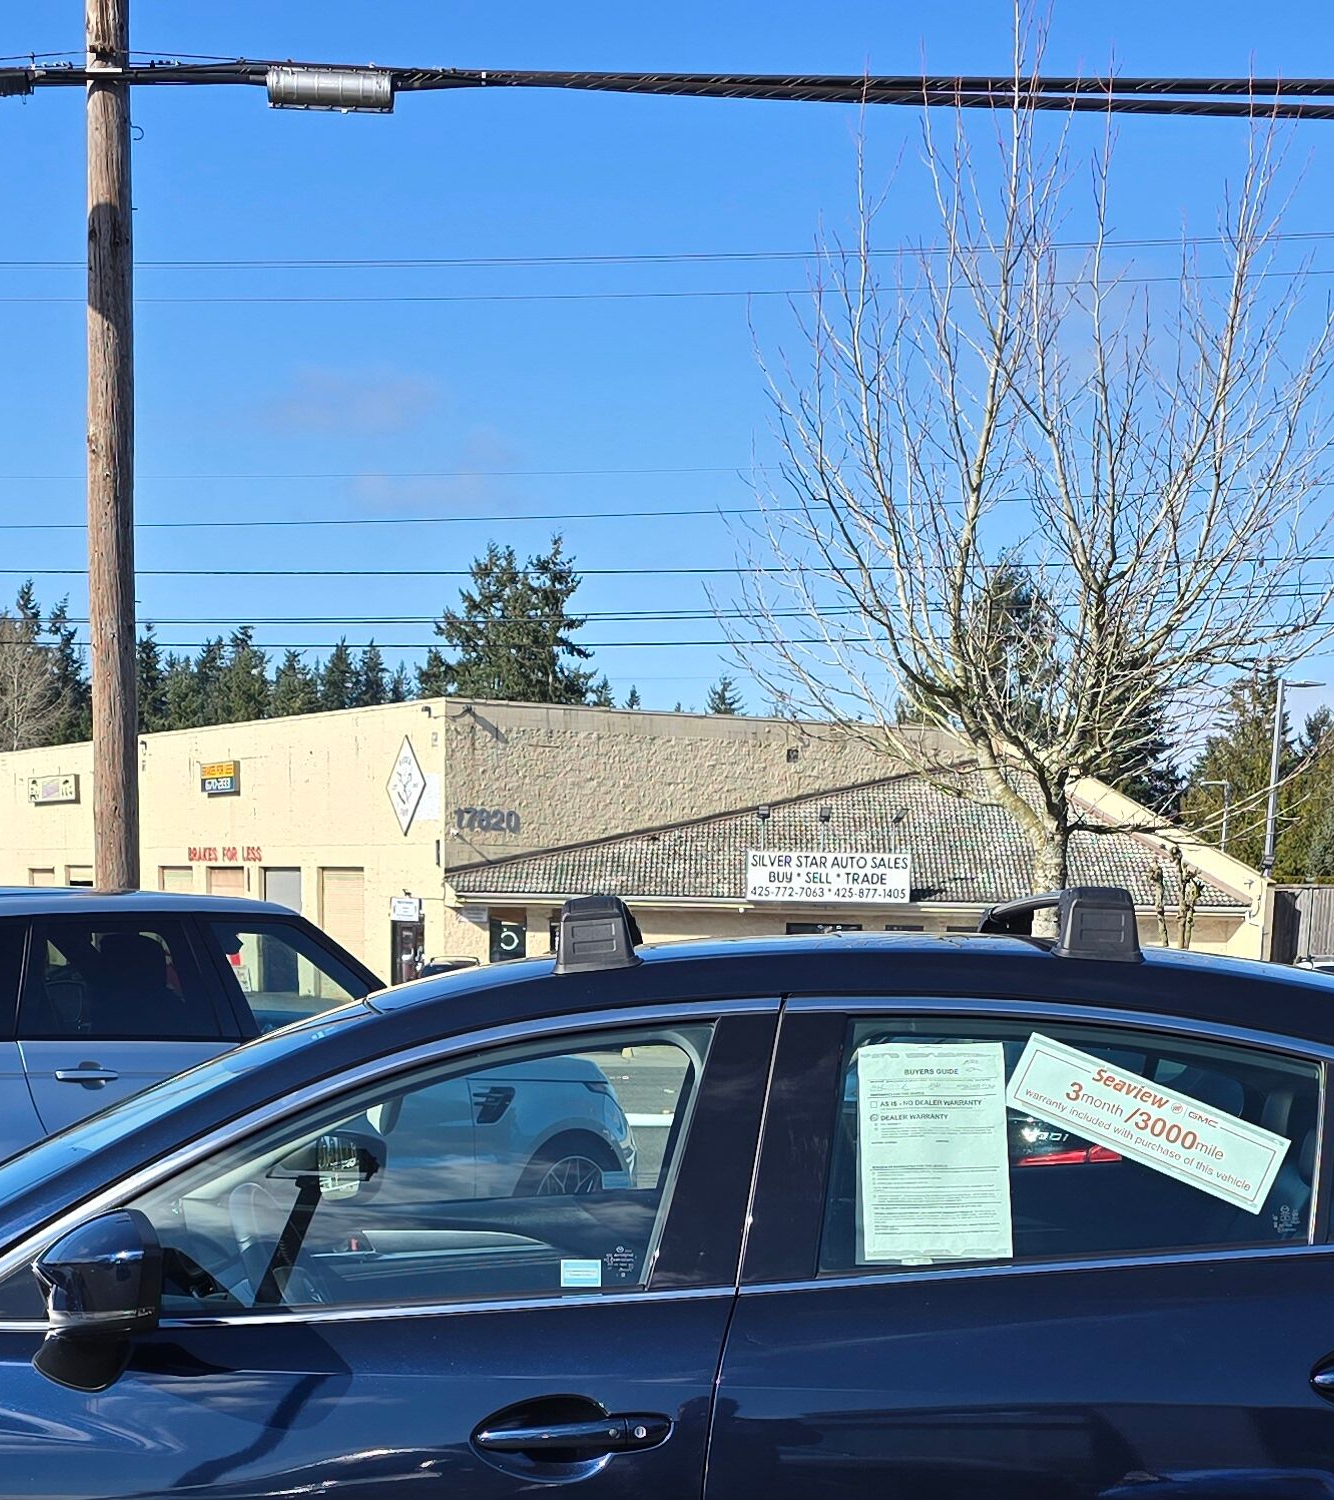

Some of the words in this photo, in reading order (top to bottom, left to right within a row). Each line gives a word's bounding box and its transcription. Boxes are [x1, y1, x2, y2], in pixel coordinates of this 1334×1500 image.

[455, 807, 521, 834] 17820
[188, 847, 218, 862] BRAKES
[222, 846, 238, 862] FOR
[242, 846, 262, 862] LESS
[751, 855, 792, 868] SILVER
[795, 855, 828, 869] STAR
[831, 856, 867, 869] AUTO
[870, 856, 908, 870] SALES
[769, 871, 793, 883] BUY
[805, 872, 832, 884] SELL
[846, 873, 887, 885] TRADE
[751, 886, 825, 898] 425-772-7063
[834, 887, 906, 899] 425-877-1405
[904, 1068, 934, 1076] BUYERS
[1091, 1067, 1170, 1109] Seaview
[1188, 1111, 1219, 1129] GMC
[1025, 1088, 1068, 1114] warranty
[1069, 1105, 1112, 1131] included
[1113, 1125, 1134, 1142] with
[1135, 1134, 1182, 1161] purchase
[1183, 1155, 1195, 1168] of
[1195, 1159, 1214, 1176] this
[1216, 1171, 1251, 1193] vehicle
